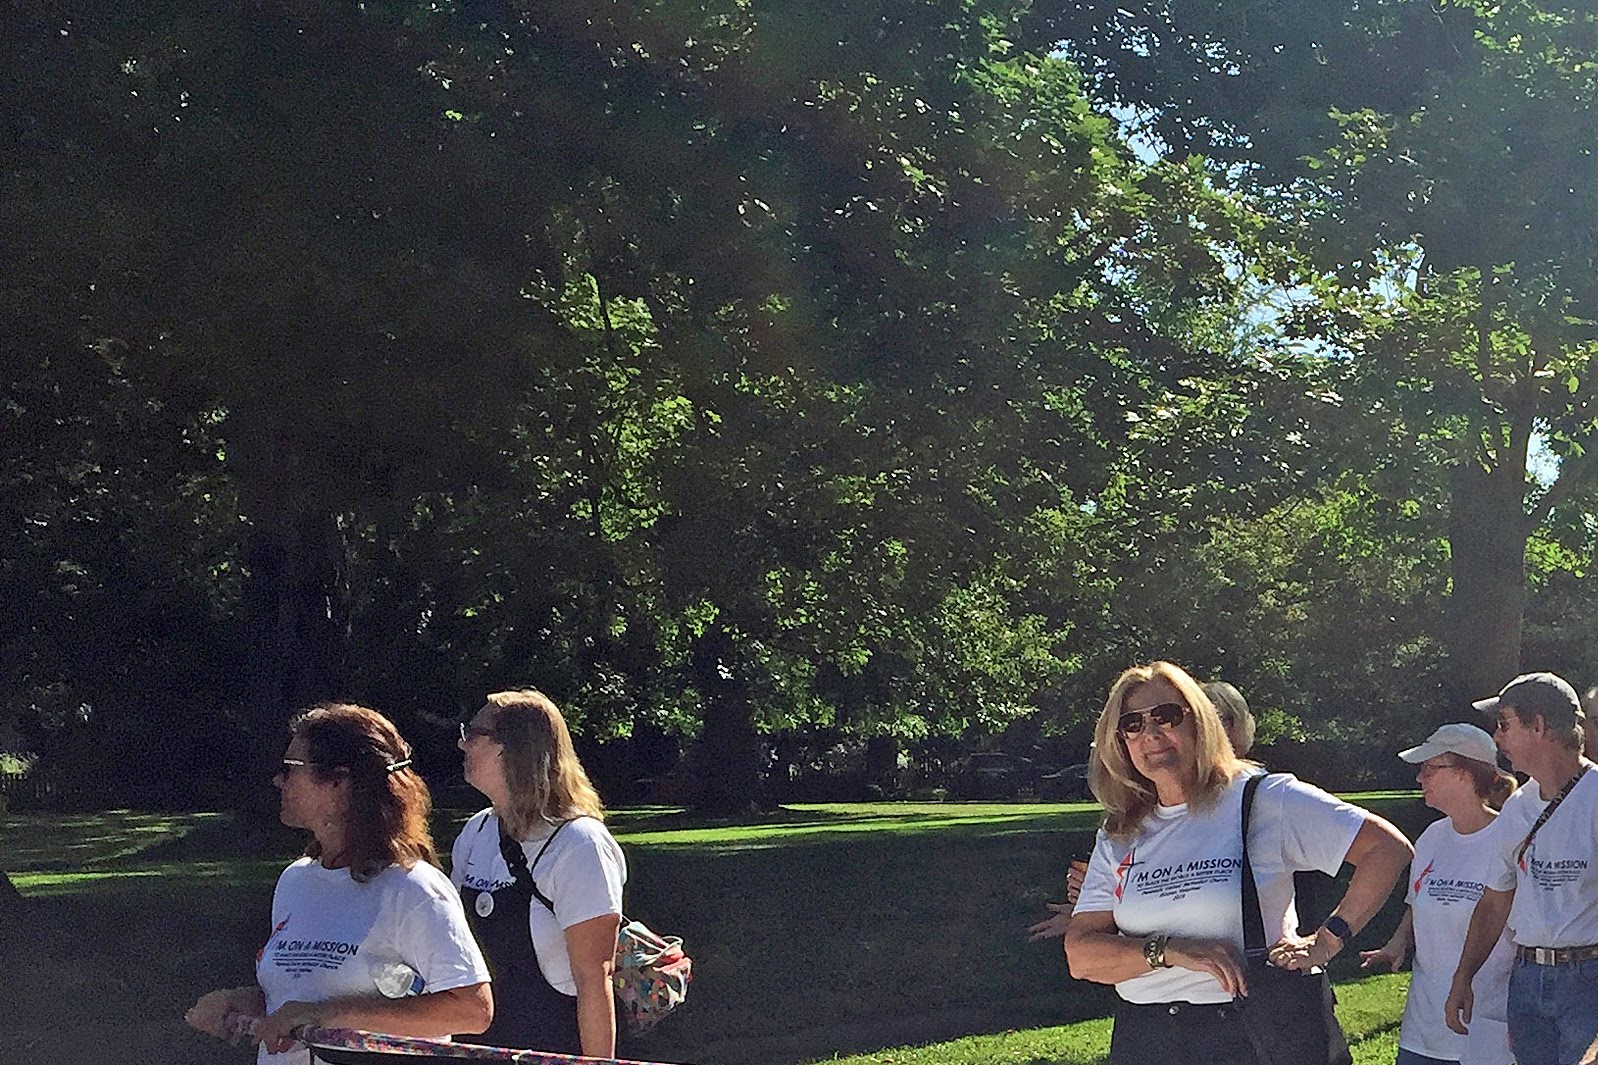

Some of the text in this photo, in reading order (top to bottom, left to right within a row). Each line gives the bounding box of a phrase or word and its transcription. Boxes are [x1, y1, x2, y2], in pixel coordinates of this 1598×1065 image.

[1152, 866, 1172, 879] ON
[1174, 864, 1183, 874] A
[1187, 858, 1242, 871] MISSION
[1456, 880, 1484, 890] MISSIO
